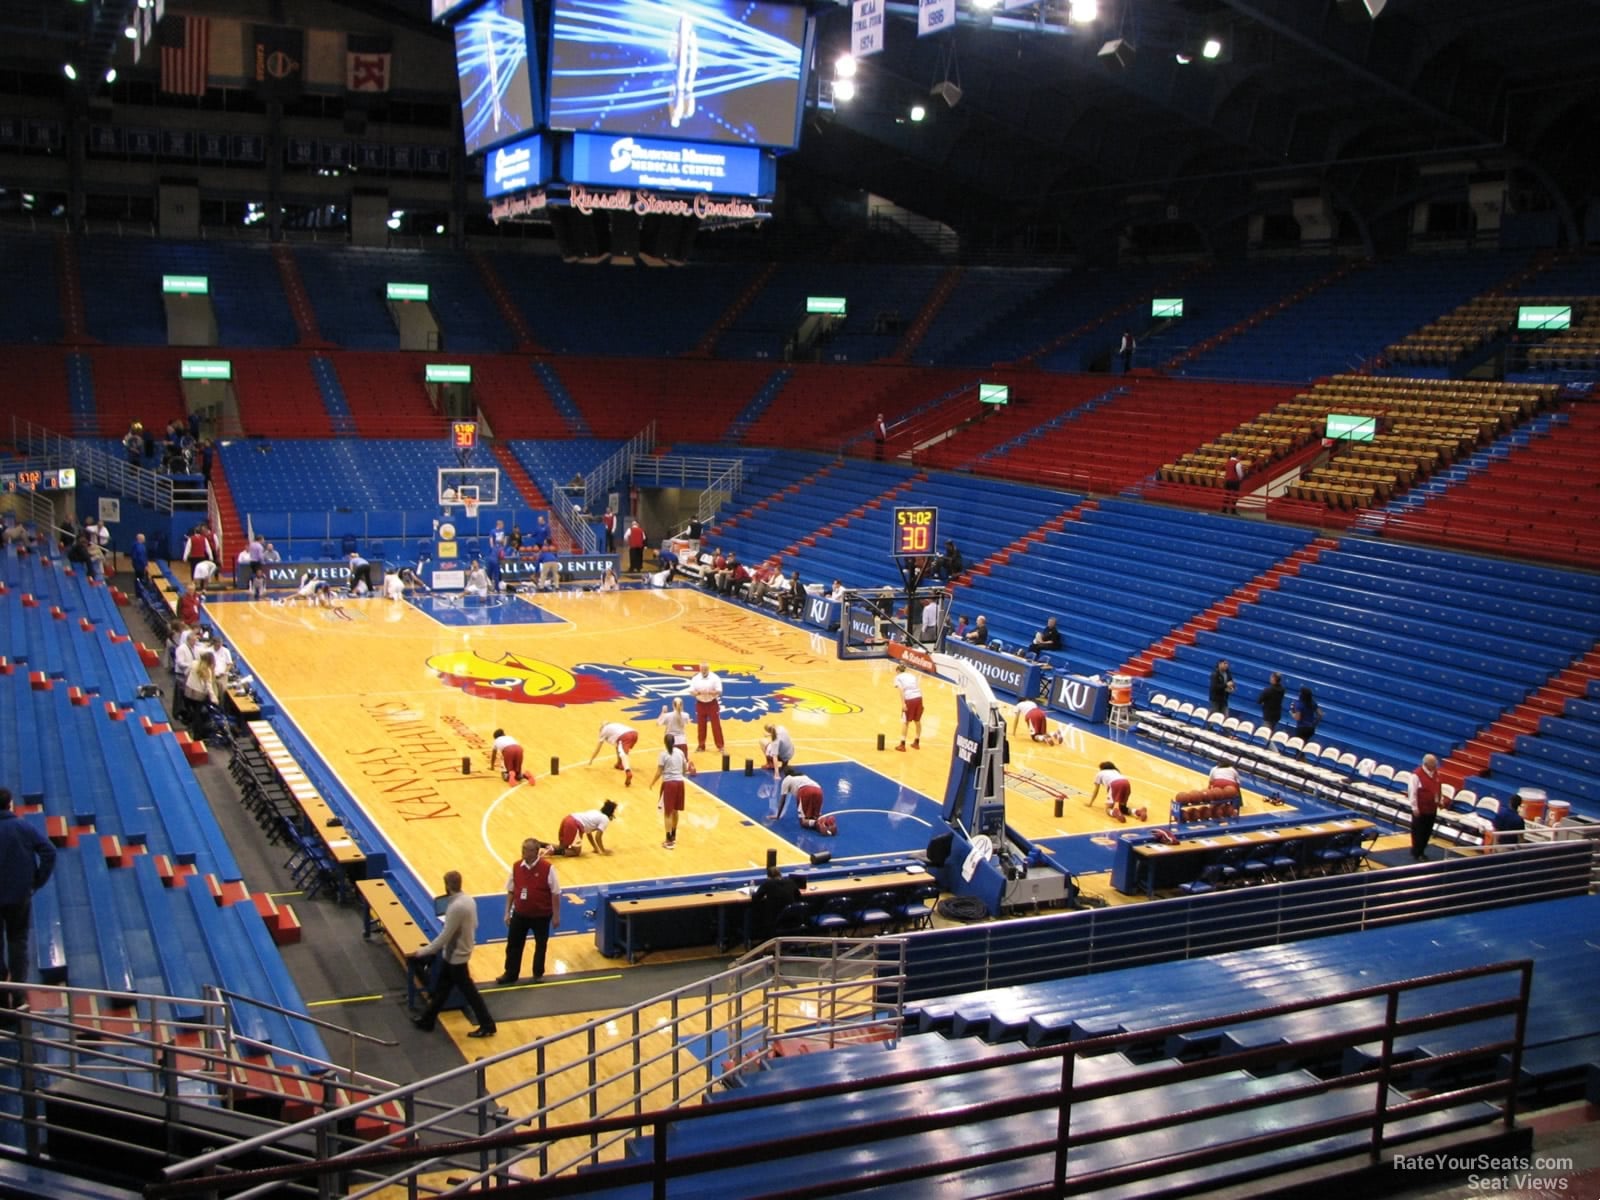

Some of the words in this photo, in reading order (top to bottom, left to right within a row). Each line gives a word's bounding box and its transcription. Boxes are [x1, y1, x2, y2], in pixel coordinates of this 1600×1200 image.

[568, 184, 632, 215] Russell
[634, 189, 693, 216] Stover
[694, 193, 756, 219] Candies
[456, 433, 473, 446] 30
[897, 511, 932, 526] 57:02
[902, 526, 927, 550] 30
[269, 568, 297, 580] PAY
[567, 560, 613, 572] ENTER
[810, 598, 829, 624] KU
[1058, 678, 1091, 711] KU
[345, 747, 461, 823] KANSAS
